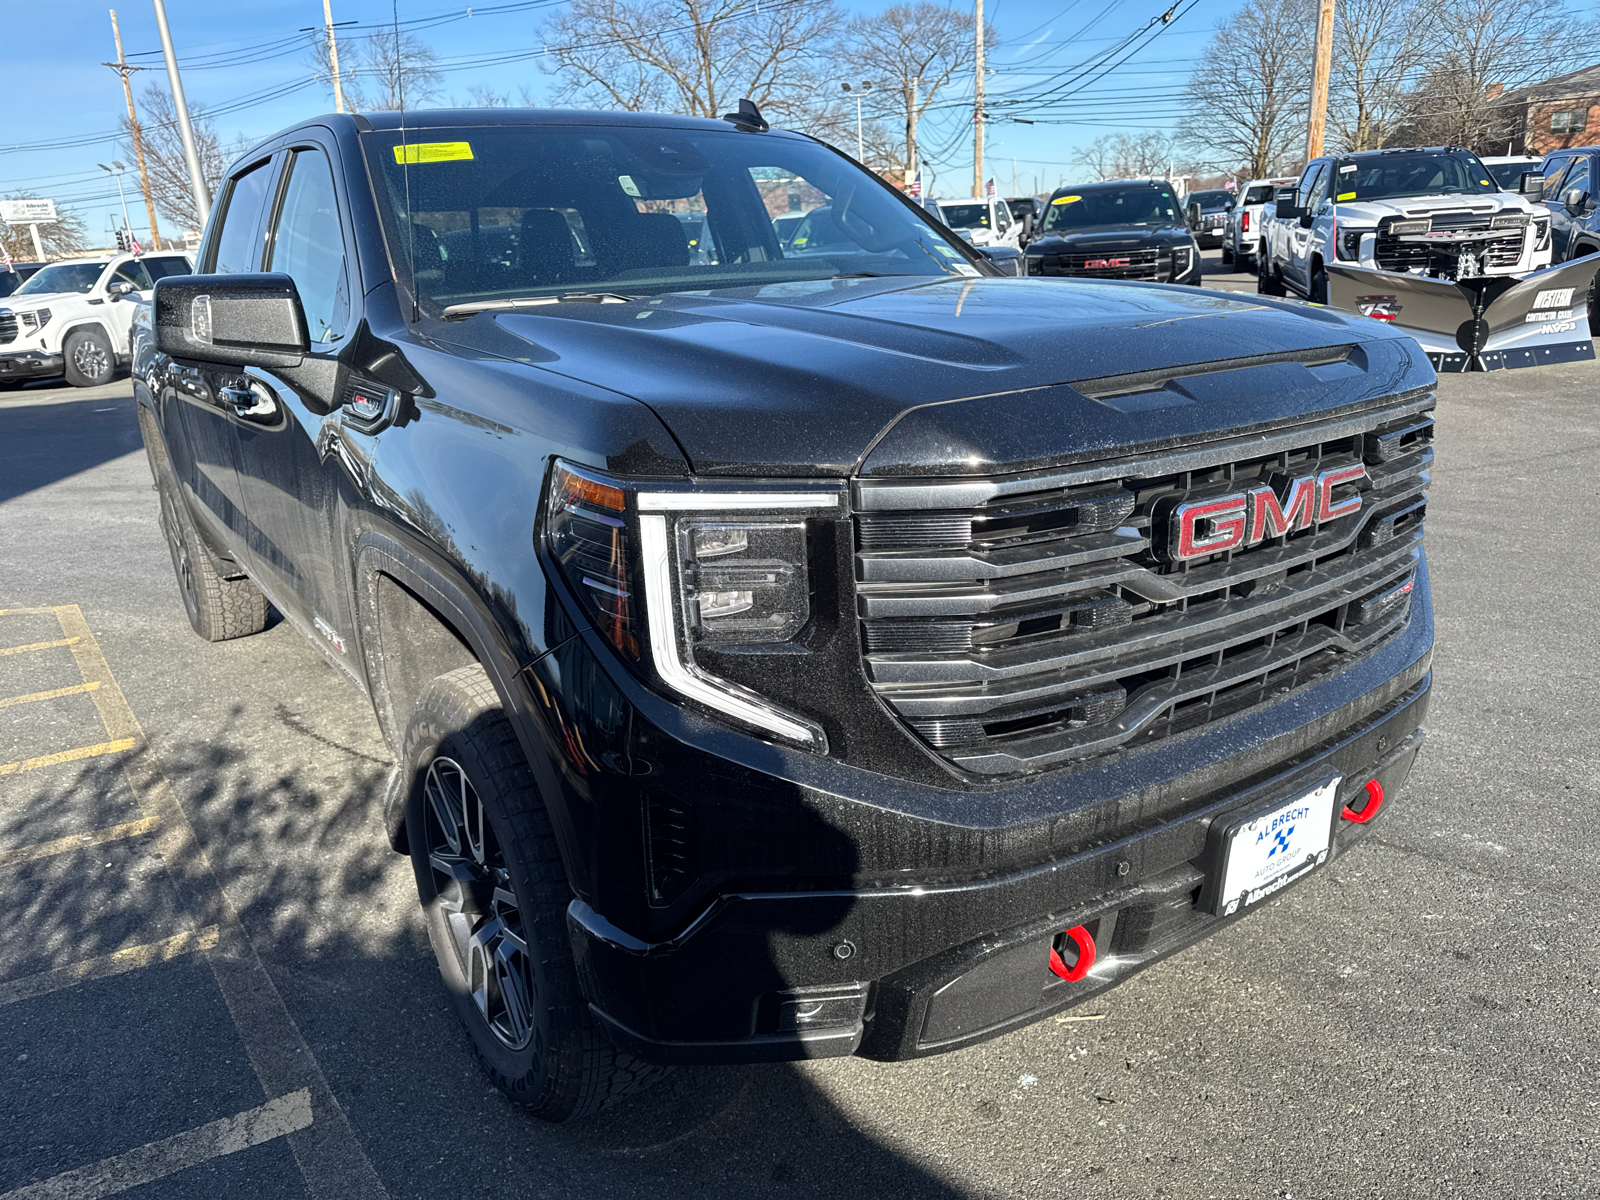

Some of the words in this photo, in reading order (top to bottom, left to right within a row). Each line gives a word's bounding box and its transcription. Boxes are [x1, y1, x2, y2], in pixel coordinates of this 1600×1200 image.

[1084, 257, 1131, 269] GMC
[1532, 287, 1576, 309] WESTERN
[1170, 462, 1366, 561] GMC
[1255, 807, 1310, 846] ALBRECHT
[1254, 862, 1276, 879] AUTO
[1276, 847, 1302, 867] GROUP
[1245, 873, 1289, 907] Albrecht
